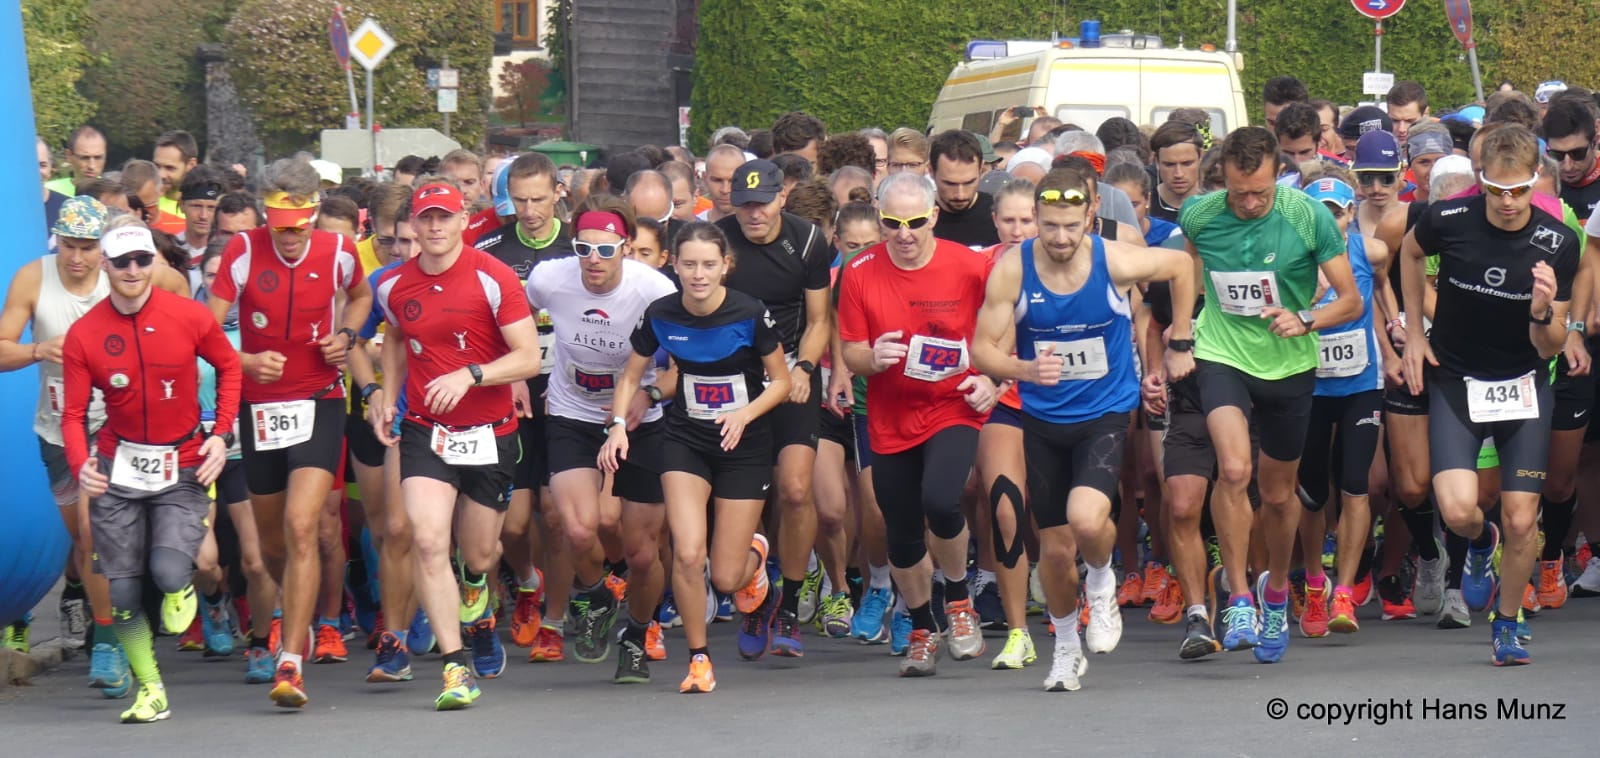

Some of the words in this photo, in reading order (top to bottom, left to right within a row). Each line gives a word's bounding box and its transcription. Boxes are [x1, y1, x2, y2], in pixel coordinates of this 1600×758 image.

[1227, 284, 1262, 300] 576
[582, 316, 611, 327] skinfit
[574, 332, 625, 349] Aicher
[924, 346, 959, 366] 723
[1053, 351, 1087, 366] 11
[1321, 344, 1354, 362] 103
[697, 385, 731, 402] 721
[1485, 385, 1520, 404] 434
[269, 413, 299, 432] 361
[447, 438, 478, 454] 237
[131, 456, 161, 474] 422
